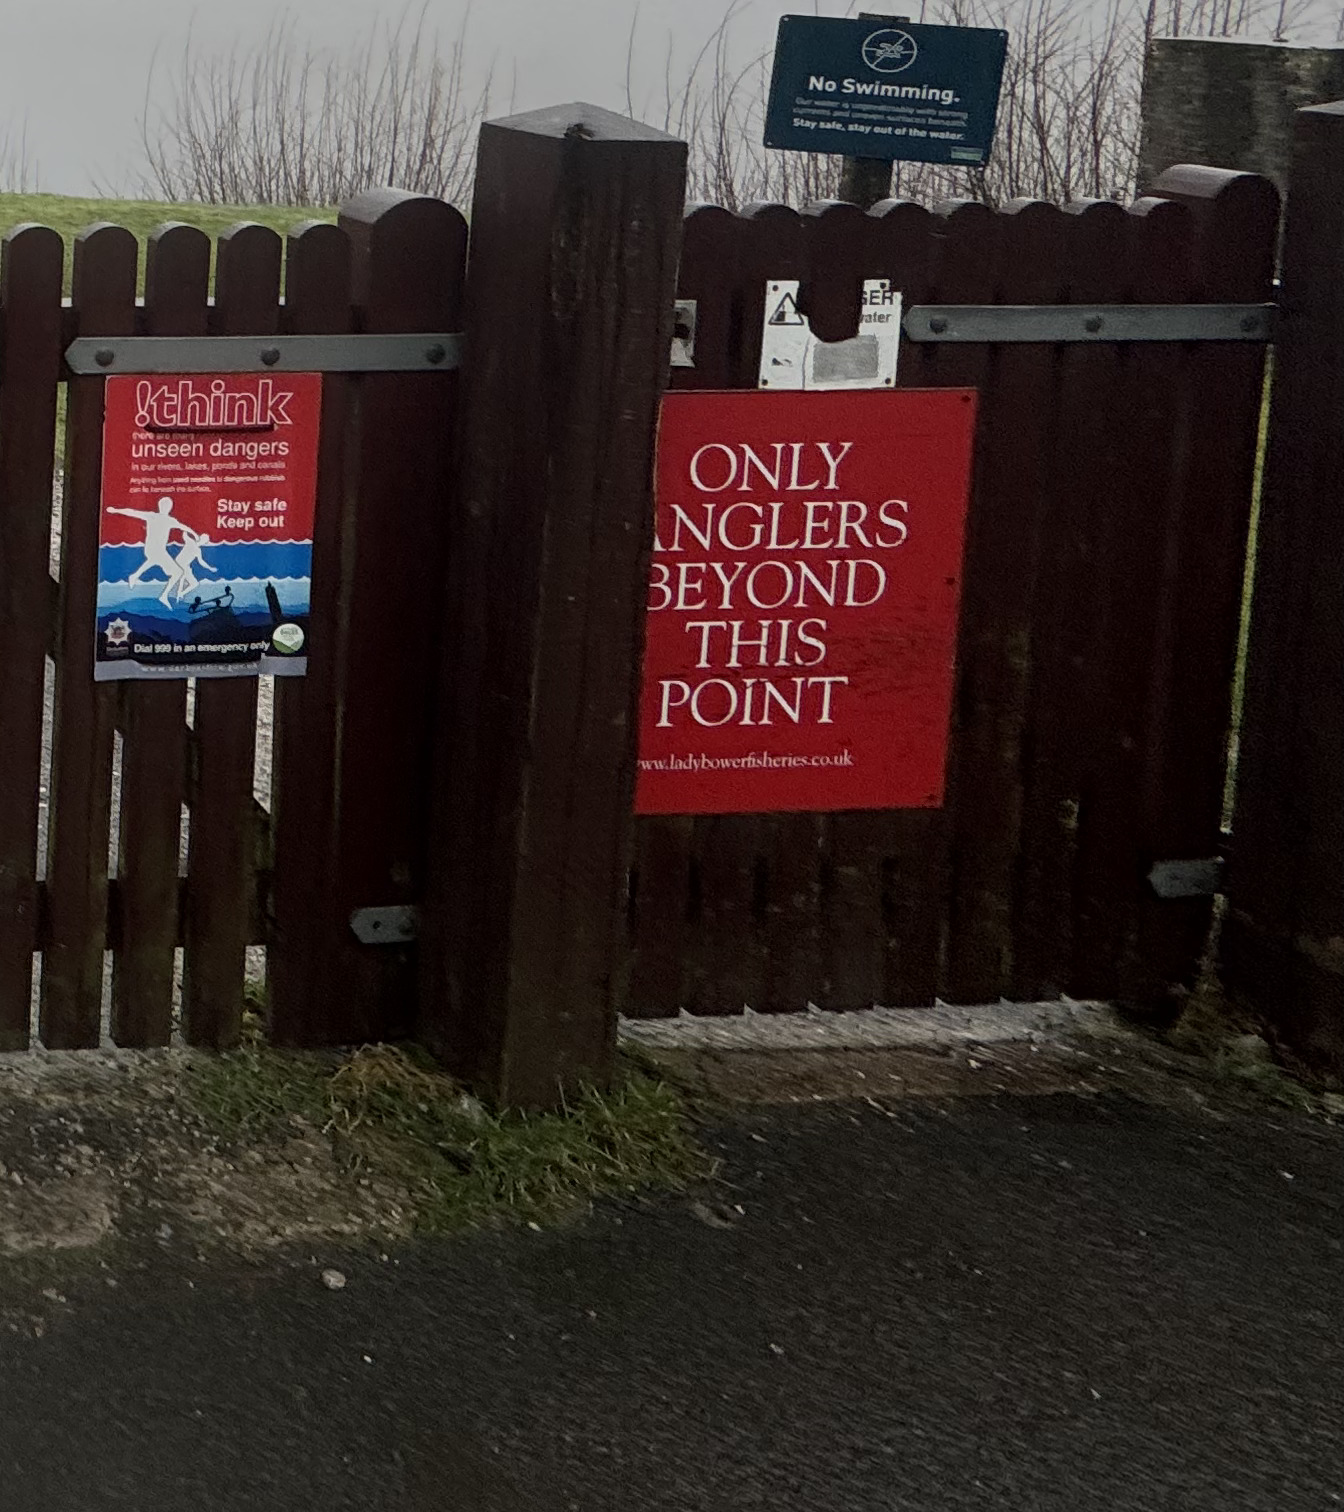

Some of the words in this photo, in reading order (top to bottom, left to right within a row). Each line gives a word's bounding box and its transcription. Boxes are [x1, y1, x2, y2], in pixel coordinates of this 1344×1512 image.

[808, 75, 837, 92] No
[841, 78, 960, 105] Swimming.
[793, 117, 817, 130] Stay
[847, 123, 871, 134] stay
[873, 126, 892, 135] out
[894, 127, 908, 136] of
[909, 127, 927, 137] the
[132, 443, 203, 458] unseen
[210, 439, 289, 460] dangers
[690, 442, 853, 492] ONLY
[217, 498, 251, 514] Stay
[254, 498, 288, 512] safe
[217, 515, 254, 531] Keep
[259, 515, 285, 528] out
[654, 500, 909, 551] NGLERS
[134, 643, 153, 653] Dial
[173, 643, 182, 653] in
[184, 643, 197, 653] an
[197, 642, 248, 654] emergency
[249, 640, 270, 652] only
[685, 618, 827, 668] THIS
[656, 676, 849, 727] POINT
[637, 748, 854, 772] ww.ladybowerfisheries.co.uk
